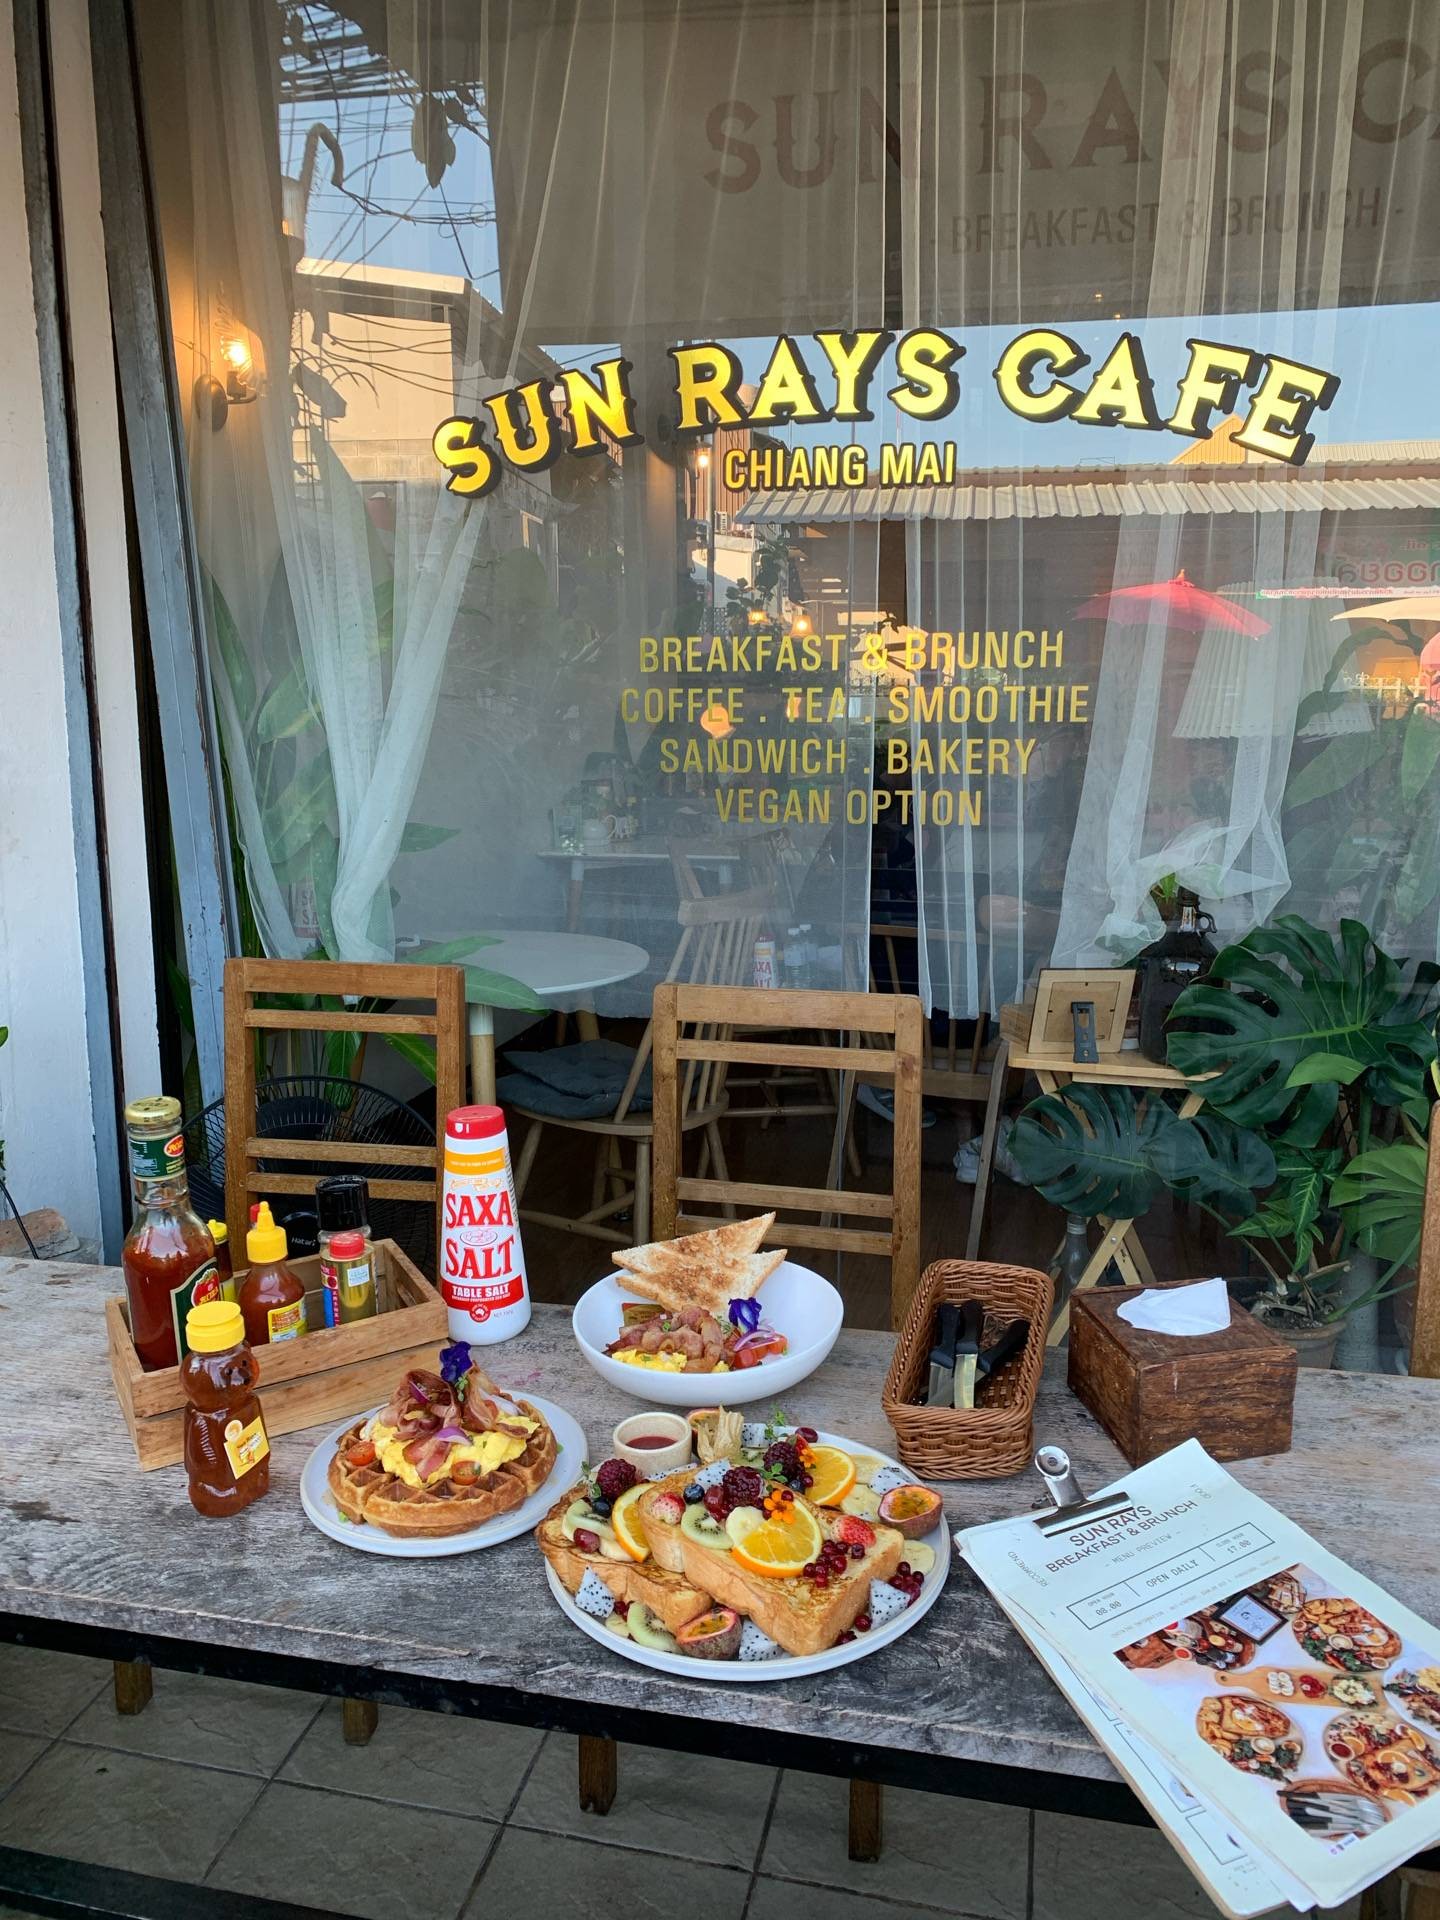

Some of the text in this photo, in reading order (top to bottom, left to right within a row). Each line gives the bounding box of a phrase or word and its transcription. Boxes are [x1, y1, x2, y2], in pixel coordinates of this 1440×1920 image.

[703, 38, 1440, 194] SUN RAYS C
[951, 203, 1158, 255] BREAKFAST
[1220, 189, 1381, 238] BRUNCH
[432, 327, 1341, 499] SUN RAYS CAFE
[723, 440, 957, 491] CHIANG MAI
[639, 630, 1064, 674] BREAKFAST & BRUNCH
[620, 687, 745, 723] COFFEE
[782, 686, 846, 723] TEA
[888, 685, 1090, 723] SMOOTHIE
[659, 738, 847, 775] SANDWICH
[887, 738, 1037, 775] BAKERY
[714, 788, 982, 826] VEGAN OPTION
[445, 1190, 514, 1229] SAXA
[445, 1235, 514, 1279] SALT
[452, 1285, 482, 1298] TABLE
[485, 1284, 510, 1297] SALT
[1045, 1500, 1198, 1573] BREAKFAST & BRUNCH
[1069, 1505, 1152, 1547] SUN RAYS
[1112, 1551, 1136, 1565] MENU
[1137, 1533, 1173, 1554] PREVIEW
[1227, 1539, 1252, 1555] 17.00
[1146, 1559, 1200, 1589] OPEN DAILY
[1095, 1600, 1122, 1617] 08.00
